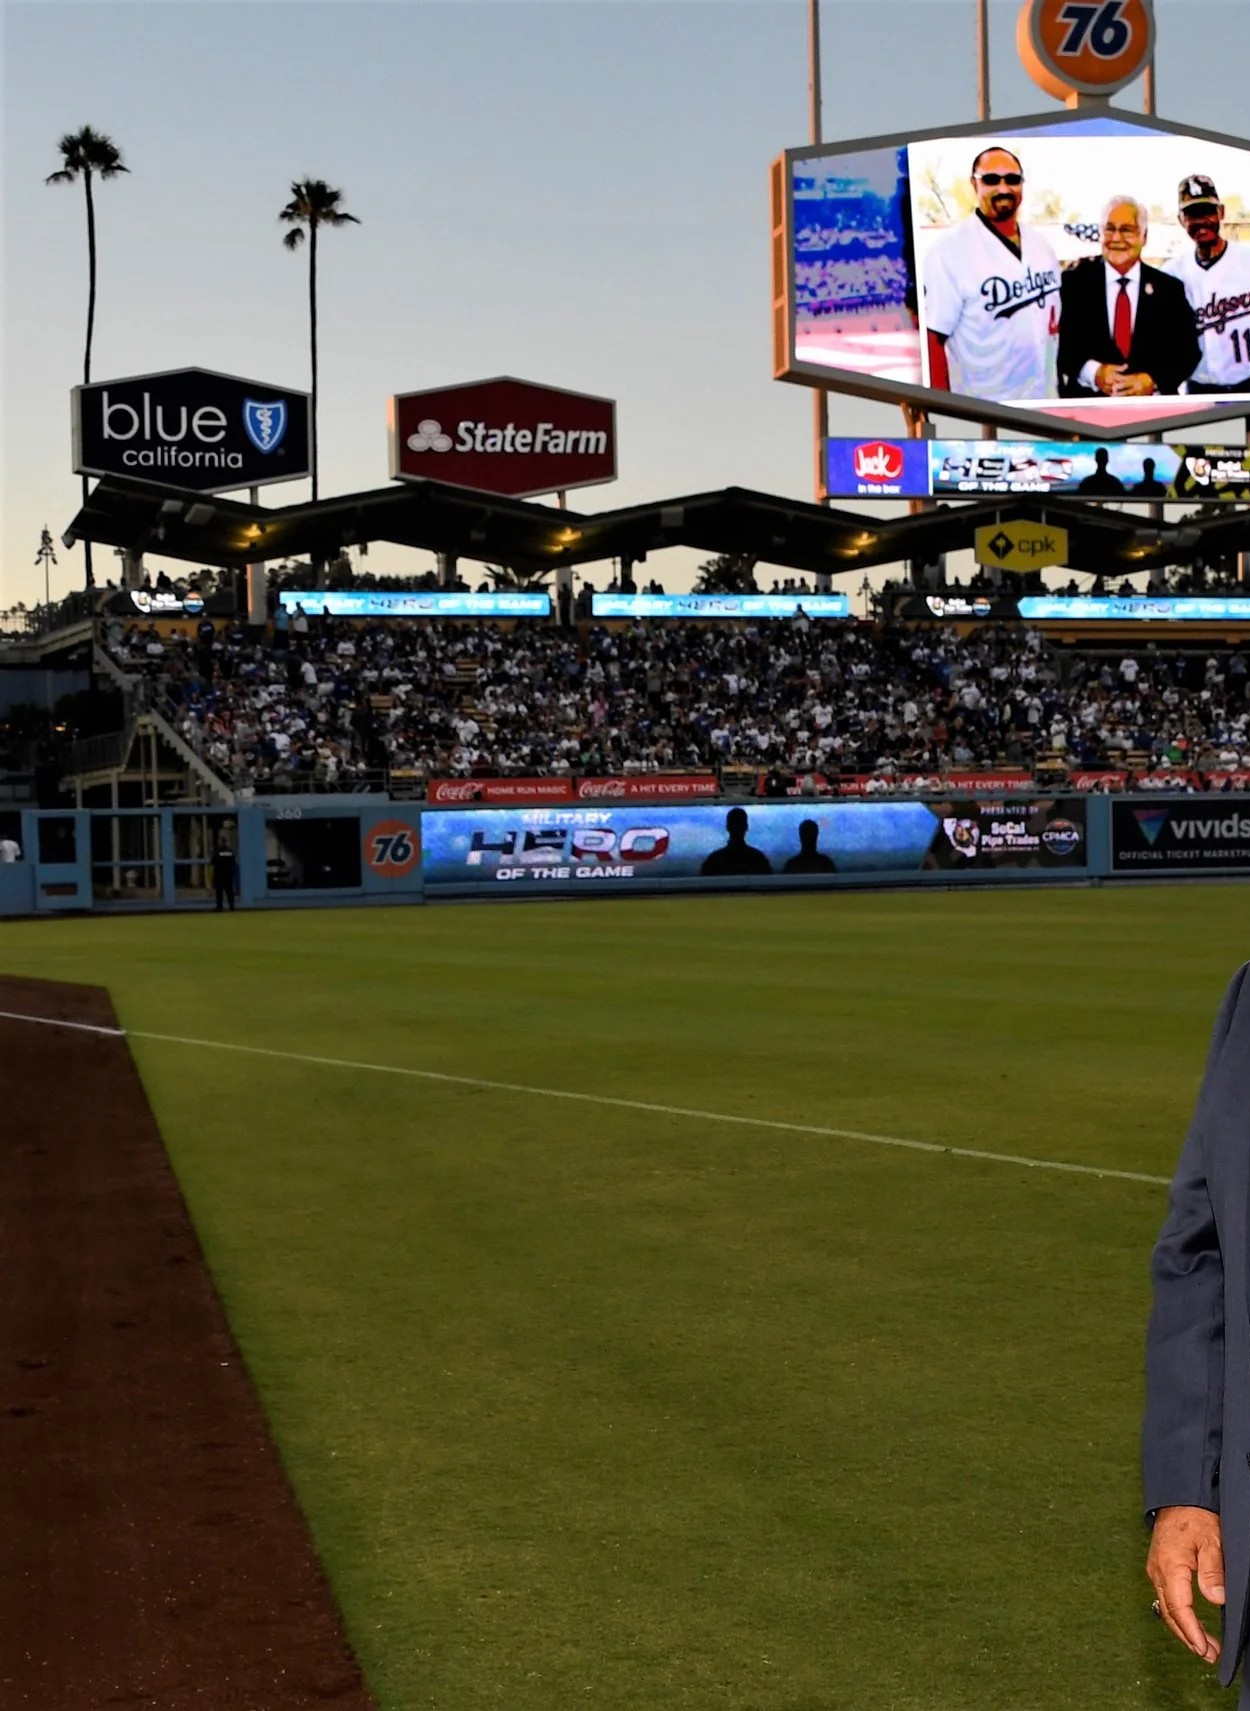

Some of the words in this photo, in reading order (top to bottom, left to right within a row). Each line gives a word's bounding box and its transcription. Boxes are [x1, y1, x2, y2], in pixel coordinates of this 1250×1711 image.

[1056, 0, 1131, 60] 76
[103, 391, 227, 442] blue
[123, 446, 242, 468] california
[856, 446, 901, 478] Jack
[939, 457, 1073, 482] HERO
[958, 481, 978, 492] OF
[982, 481, 1007, 492] THE
[1010, 481, 1051, 492] GAME
[1018, 536, 1056, 557] cpk
[579, 781, 626, 797] Coca-Cola
[631, 784, 638, 793] A
[640, 784, 657, 792] HIT
[658, 784, 689, 793] EVERY
[692, 783, 716, 792] TIME
[522, 812, 612, 825] MILITARY
[371, 830, 414, 865] 76
[466, 828, 670, 865] HERO
[1119, 851, 1163, 860] OFFICIAL
[1167, 850, 1200, 859] TICKET
[496, 868, 526, 880] OF
[531, 867, 570, 879] THE
[576, 865, 635, 878] GAME
